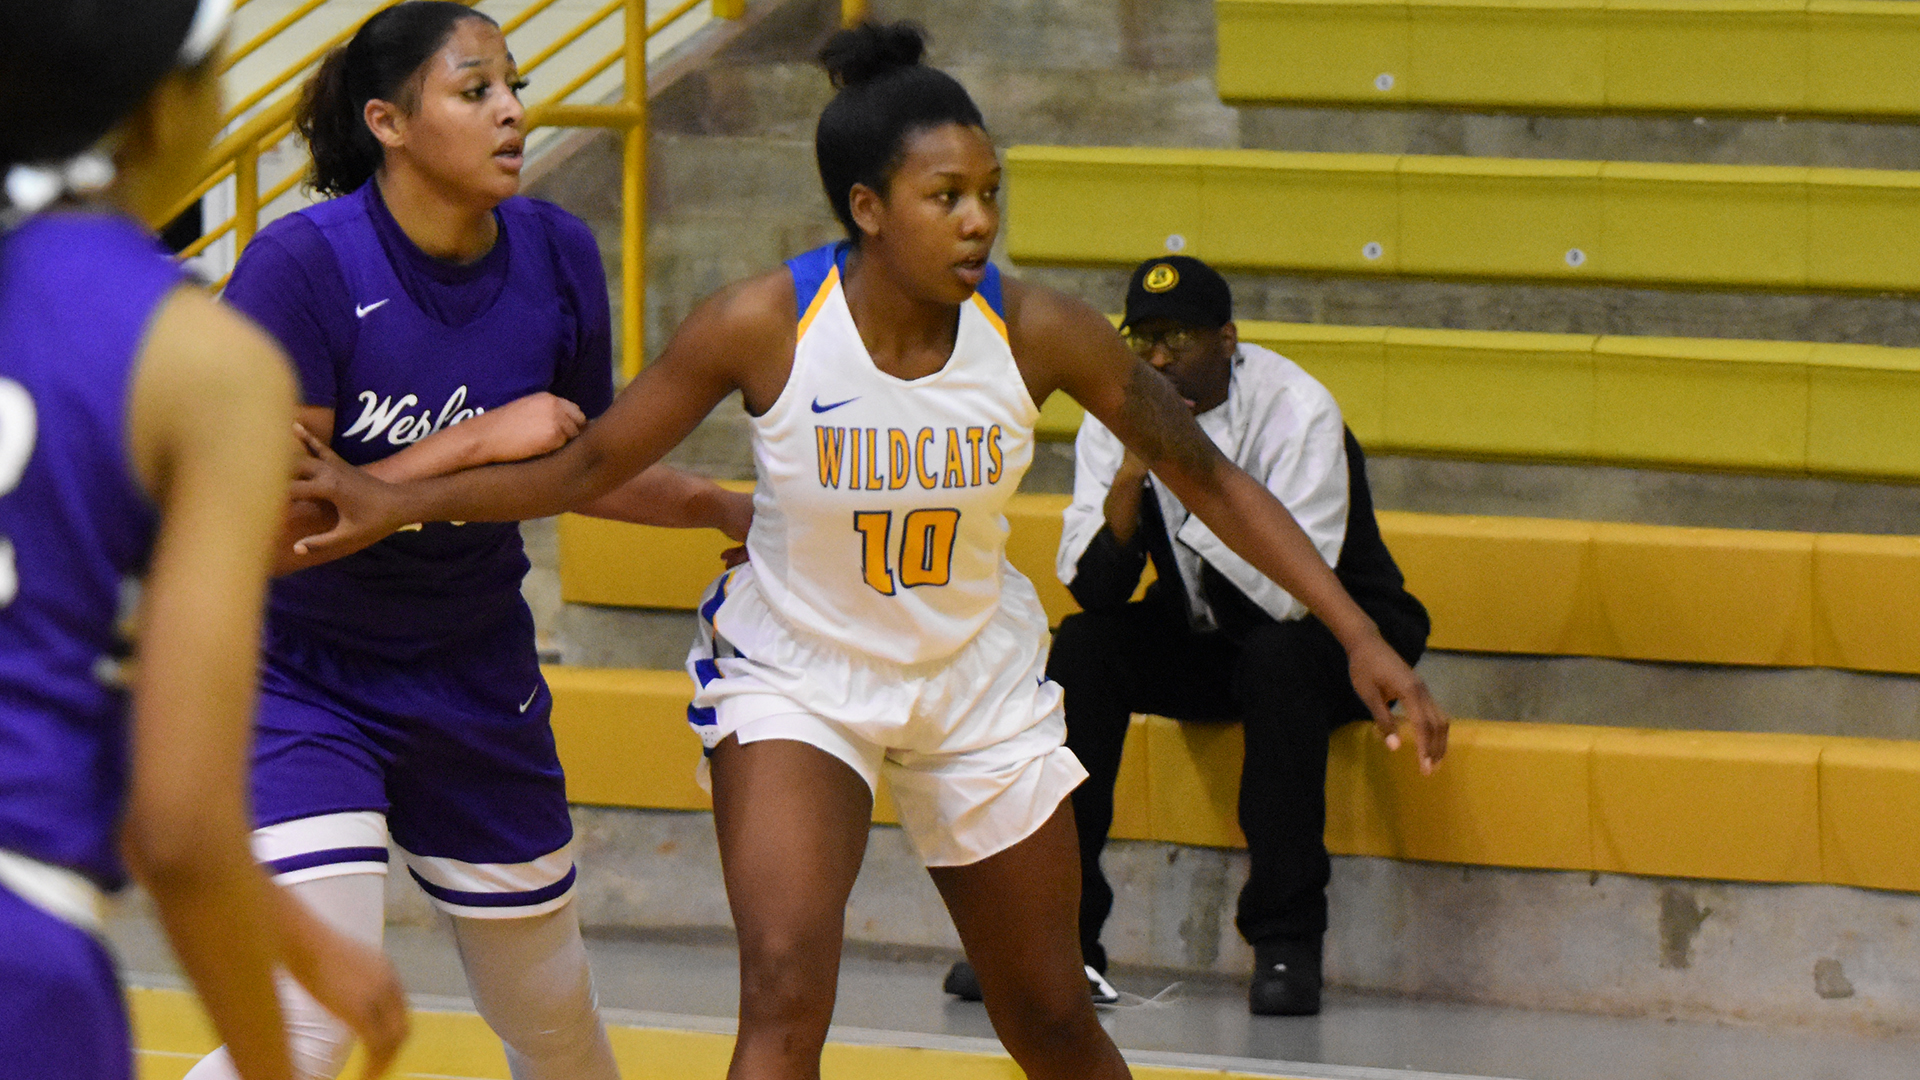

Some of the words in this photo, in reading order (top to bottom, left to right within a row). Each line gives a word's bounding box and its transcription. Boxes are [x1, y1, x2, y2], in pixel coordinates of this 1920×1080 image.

[341, 384, 485, 445] Wesl
[815, 424, 1003, 490] WILDCATS
[853, 507, 961, 596] 10
